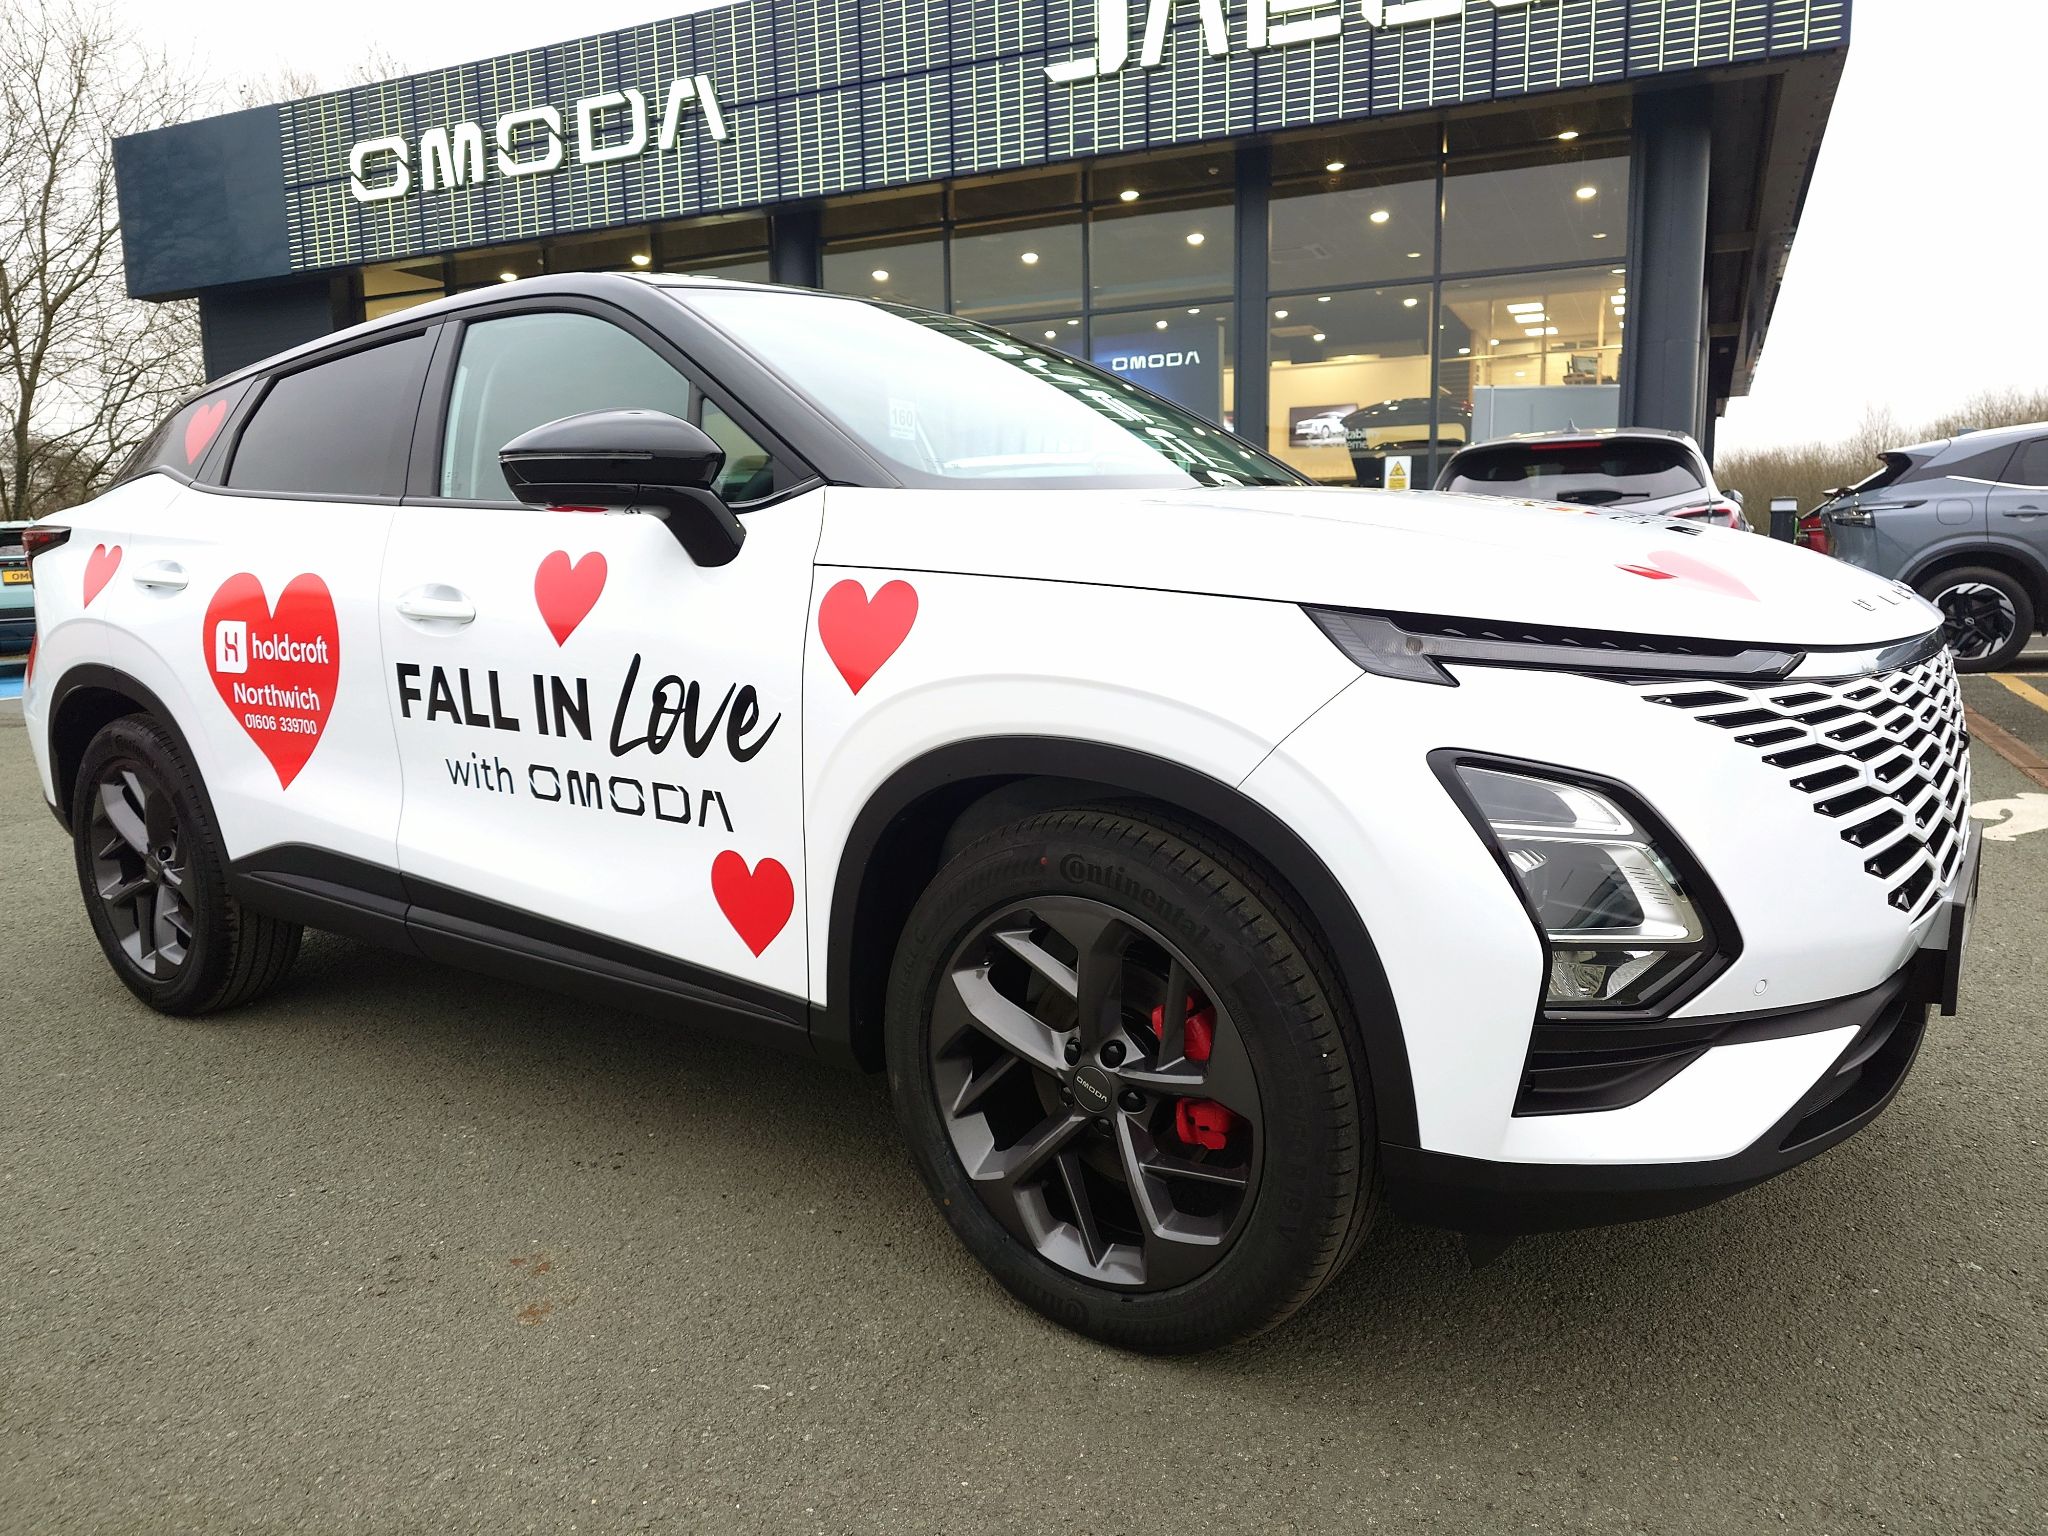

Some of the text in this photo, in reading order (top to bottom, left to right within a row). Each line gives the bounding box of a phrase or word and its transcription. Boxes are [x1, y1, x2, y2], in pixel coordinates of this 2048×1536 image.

[1043, 0, 1546, 82] JAE
[350, 74, 728, 203] OMODA
[1112, 351, 1200, 371] OMODA
[892, 407, 914, 428] 160
[252, 632, 329, 665] holdcroft
[233, 682, 321, 711] Northwich
[396, 653, 782, 763] FALL IN Love
[245, 713, 318, 735] 01606 339700
[445, 751, 735, 833] with OMODA
[1059, 852, 1211, 941] Continental
[1076, 1075, 1108, 1103] OMODA
